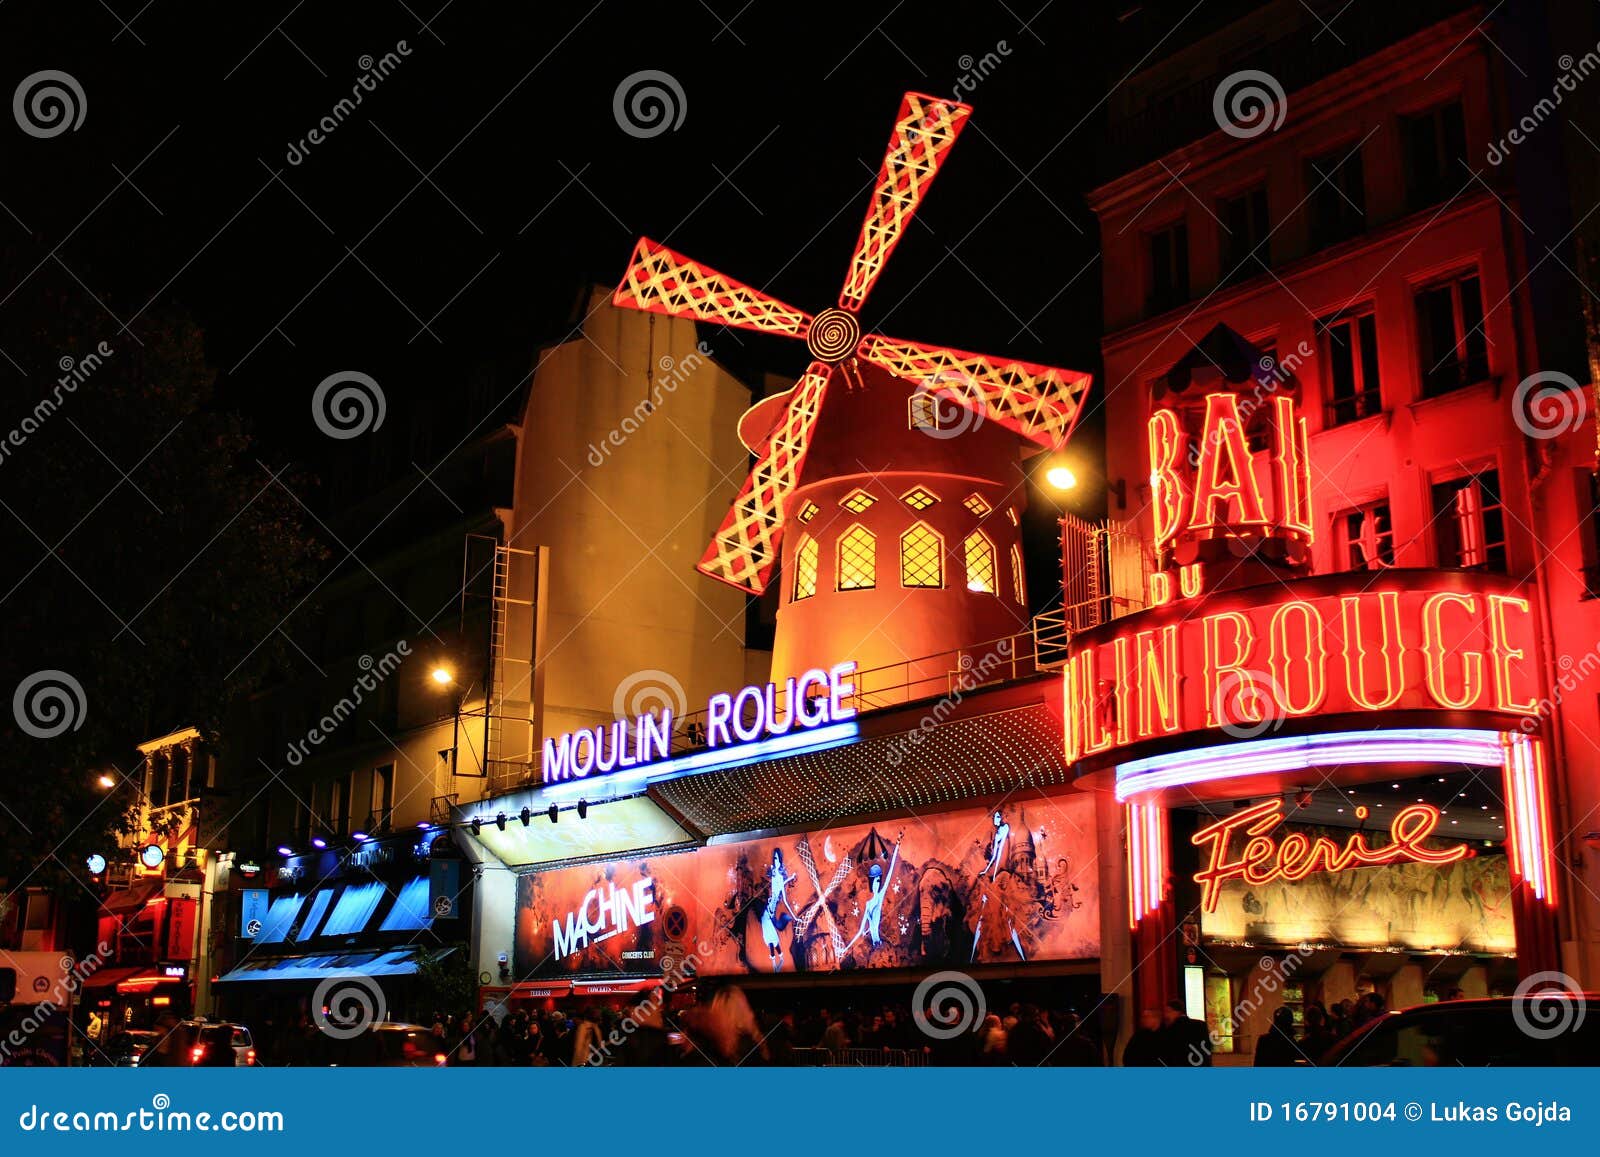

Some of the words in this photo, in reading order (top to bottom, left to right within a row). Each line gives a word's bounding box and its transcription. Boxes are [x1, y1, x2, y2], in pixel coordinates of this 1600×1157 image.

[1148, 392, 1314, 555] BAL
[1150, 562, 1203, 606] DU
[1203, 592, 1540, 728] ROUGE
[542, 708, 673, 784] MOULIN
[708, 661, 859, 748] ROUGE
[552, 877, 656, 961] MACHINE
[166, 967, 185, 976] BAR
